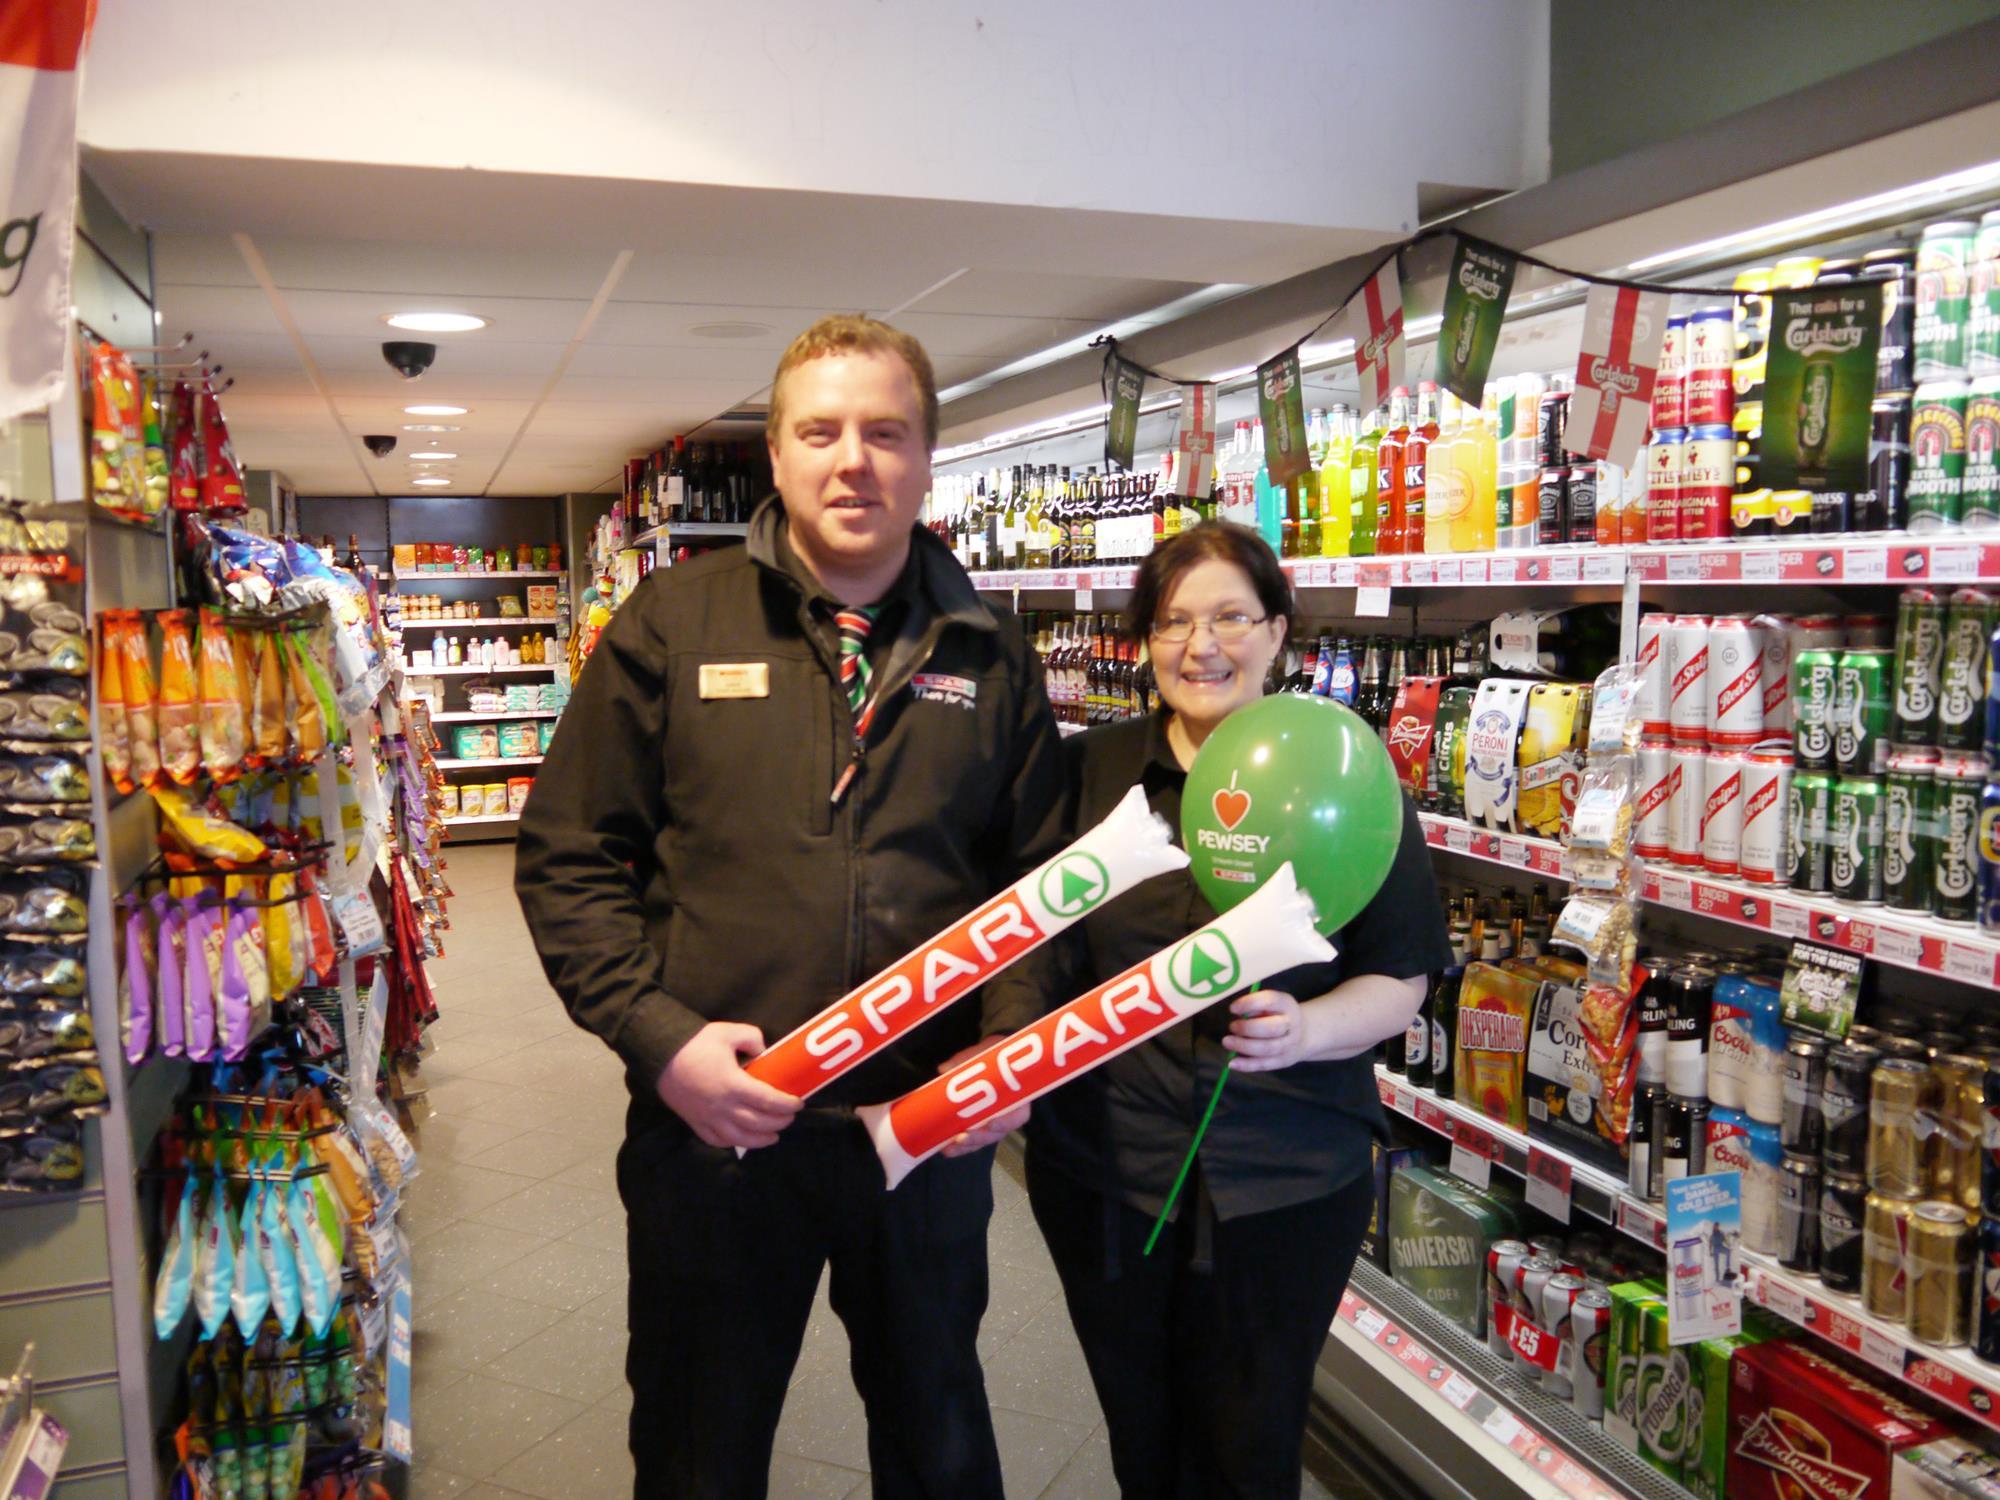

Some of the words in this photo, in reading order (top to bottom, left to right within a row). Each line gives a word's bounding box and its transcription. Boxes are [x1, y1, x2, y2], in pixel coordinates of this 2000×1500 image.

[1459, 261, 1502, 300] Carlsberg
[1788, 301, 1813, 315] That
[1813, 300, 1838, 314] calls
[1840, 297, 1855, 312] for
[1856, 300, 1865, 311] a
[1785, 315, 1863, 357] Carlsberg
[1590, 357, 1641, 394] Carlsberg
[1897, 618, 1943, 721] Carlsberg
[1939, 619, 1985, 725] Carlsberg
[1798, 666, 1837, 759] Carlsberg
[1836, 668, 1867, 763] Carlsberg
[1438, 721, 1455, 772] Citrus
[1472, 733, 1509, 752] PERONI
[1230, 769, 1238, 791] I
[1197, 829, 1271, 854] PEWSEY
[1832, 794, 1864, 888] Carlsberg
[1884, 785, 1916, 885] Carlsberg
[1937, 793, 1978, 898] Carlsberg
[1698, 885, 1730, 904] UNDER
[1698, 897, 1713, 912] 25?
[1851, 921, 1873, 939] UND
[1792, 948, 1810, 961] FOR
[1811, 952, 1828, 966] THE
[1828, 958, 1860, 975] MATCH
[805, 902, 1036, 1071] SPAR
[946, 972, 1164, 1120] SPAR
[1460, 1008, 1524, 1051] DESPERADOS
[1714, 1025, 1750, 1055] Coors
[1712, 1145, 1750, 1170] Coors
[1677, 1199, 1703, 1213] COLD
[1704, 1191, 1730, 1206] BEER
[1393, 1236, 1477, 1268] SOMERSBY
[1426, 1287, 1460, 1301] CIDER
[1645, 1373, 1683, 1440] TUBORG
[1752, 1425, 1852, 1500] Budweise
